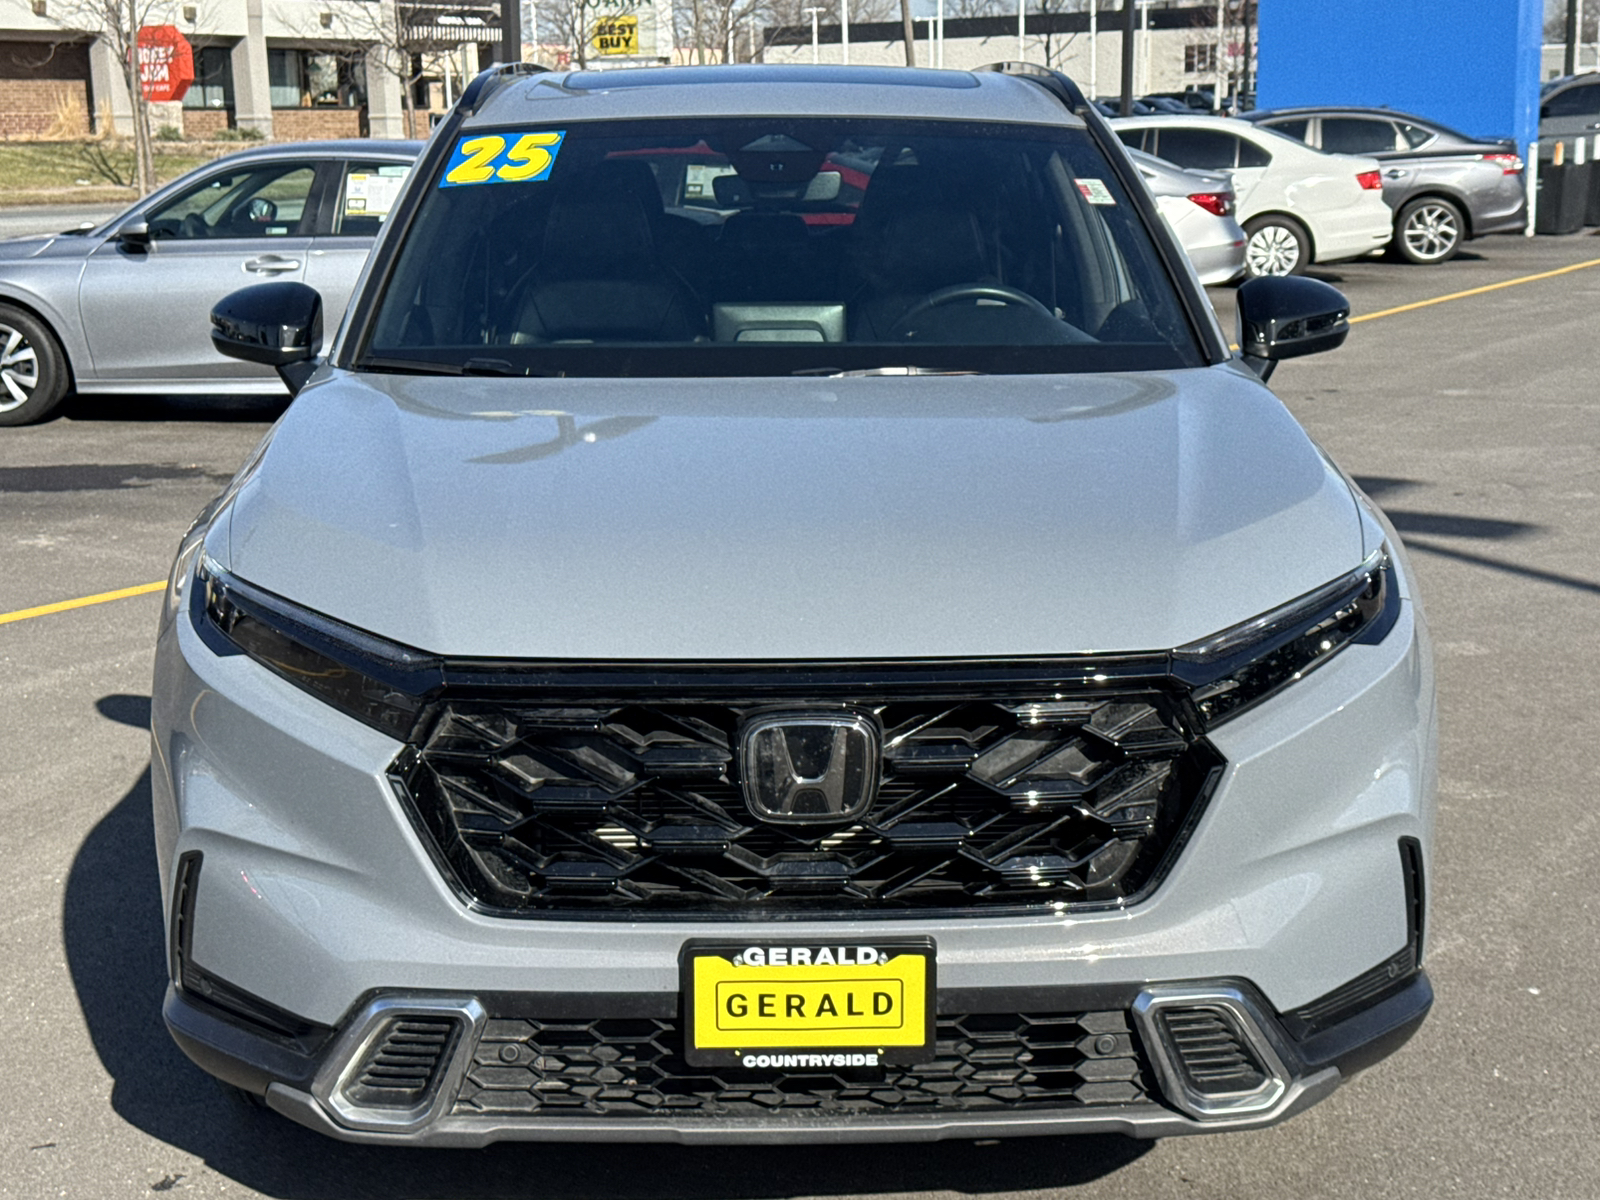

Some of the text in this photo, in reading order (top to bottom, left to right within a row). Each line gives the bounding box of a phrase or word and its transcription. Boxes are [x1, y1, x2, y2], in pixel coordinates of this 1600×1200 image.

[597, 24, 635, 35] BEST
[599, 37, 632, 49] BUY
[446, 133, 562, 184] 25
[743, 946, 879, 967] GERALD
[726, 992, 894, 1018] GERALD
[742, 1053, 879, 1068] COUNTRYSIDE
